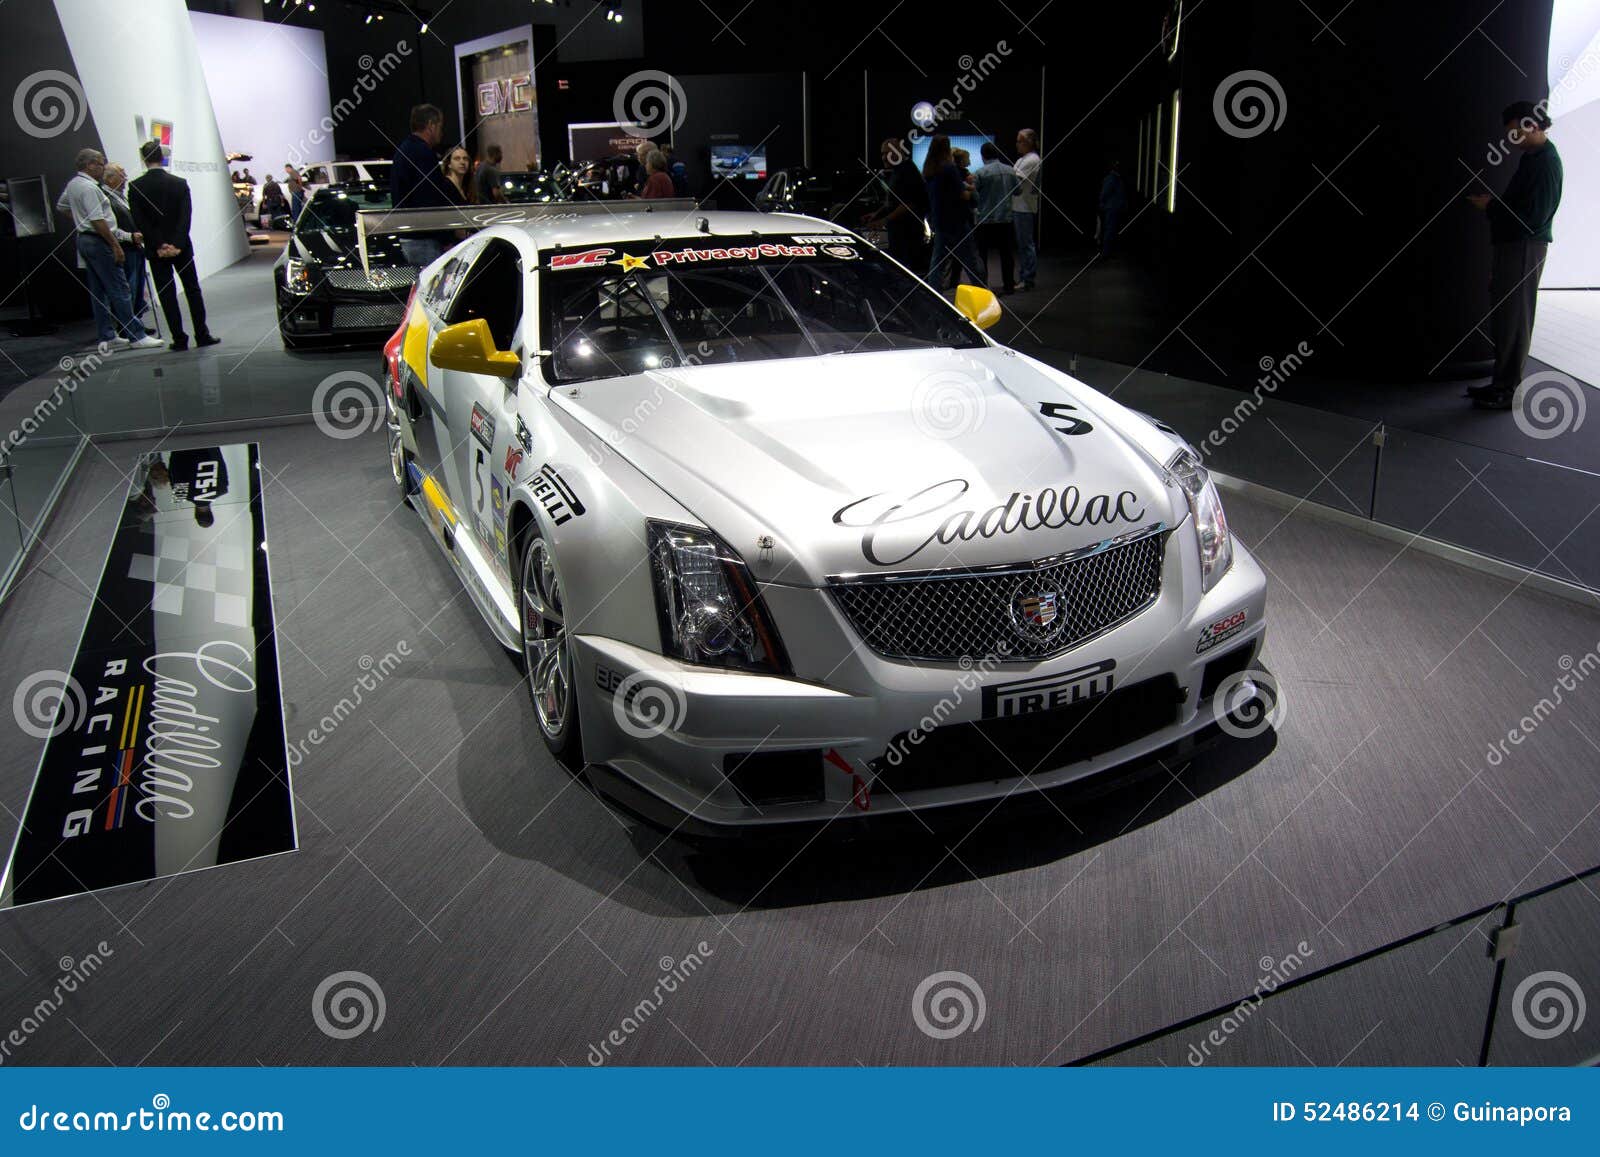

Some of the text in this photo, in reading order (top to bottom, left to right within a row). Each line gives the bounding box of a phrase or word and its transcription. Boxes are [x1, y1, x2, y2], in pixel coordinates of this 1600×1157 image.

[477, 73, 532, 117] GMC
[609, 138, 648, 146] ACADI
[652, 243, 817, 266] PrivacyStar
[1038, 401, 1094, 436] 5
[193, 461, 219, 502] CTS-V
[474, 449, 484, 513] 5
[527, 463, 586, 526] PRELLI
[832, 478, 1146, 567] Cadillac
[1213, 611, 1245, 635] SCCA
[981, 658, 1117, 720] PIRELLI
[62, 658, 128, 838] RACING
[135, 640, 257, 822] Cadillac
